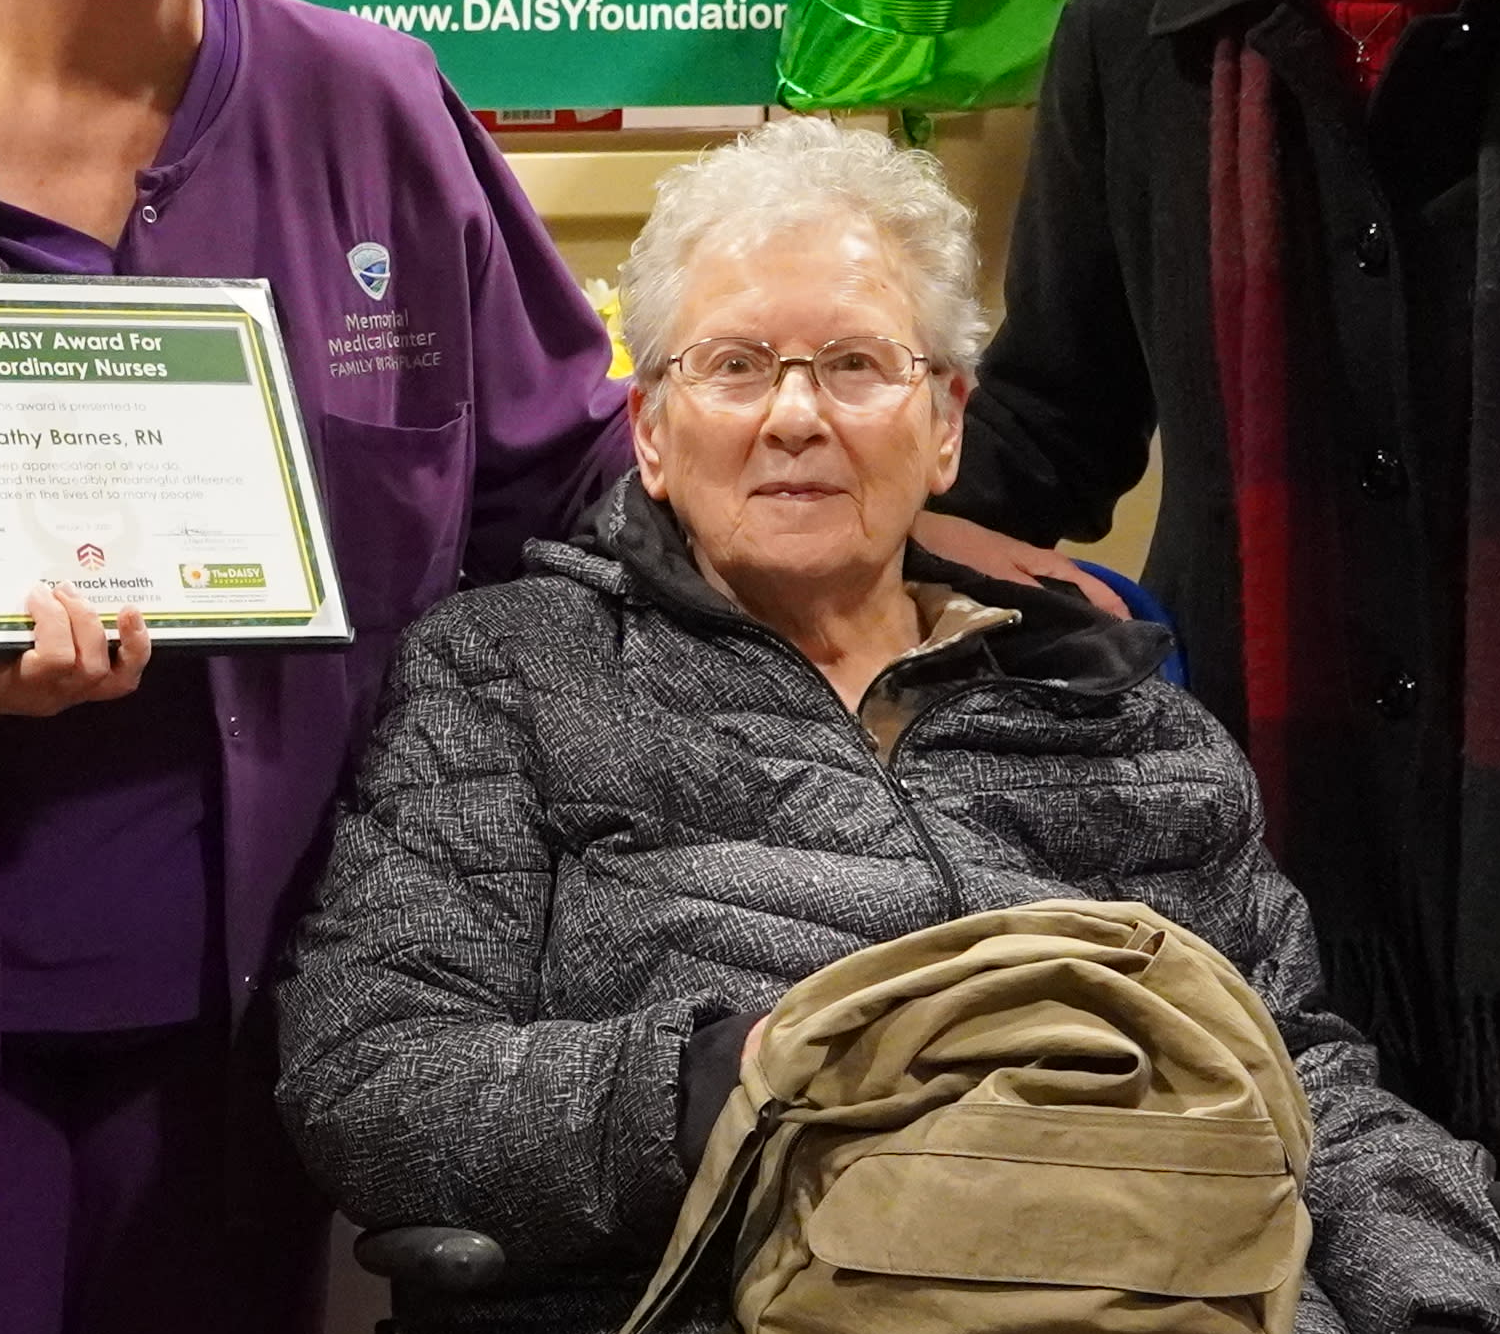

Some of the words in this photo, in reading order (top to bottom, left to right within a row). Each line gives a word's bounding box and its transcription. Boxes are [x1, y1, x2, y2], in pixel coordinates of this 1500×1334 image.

[345, 308, 408, 331] Memorial
[53, 333, 124, 350] Award
[131, 334, 162, 351] For
[328, 331, 386, 356] Medical
[386, 331, 436, 348] Center
[95, 358, 167, 377] Nurses
[329, 358, 373, 378] FAMILY
[16, 400, 56, 411] award
[59, 401, 66, 411] is
[70, 401, 130, 414] presented
[133, 403, 146, 411] to
[50, 429, 128, 447] Barnes,
[135, 429, 163, 445] RN
[228, 568, 261, 578] DAISY
[40, 579, 108, 589] aarack
[110, 579, 153, 588] Health
